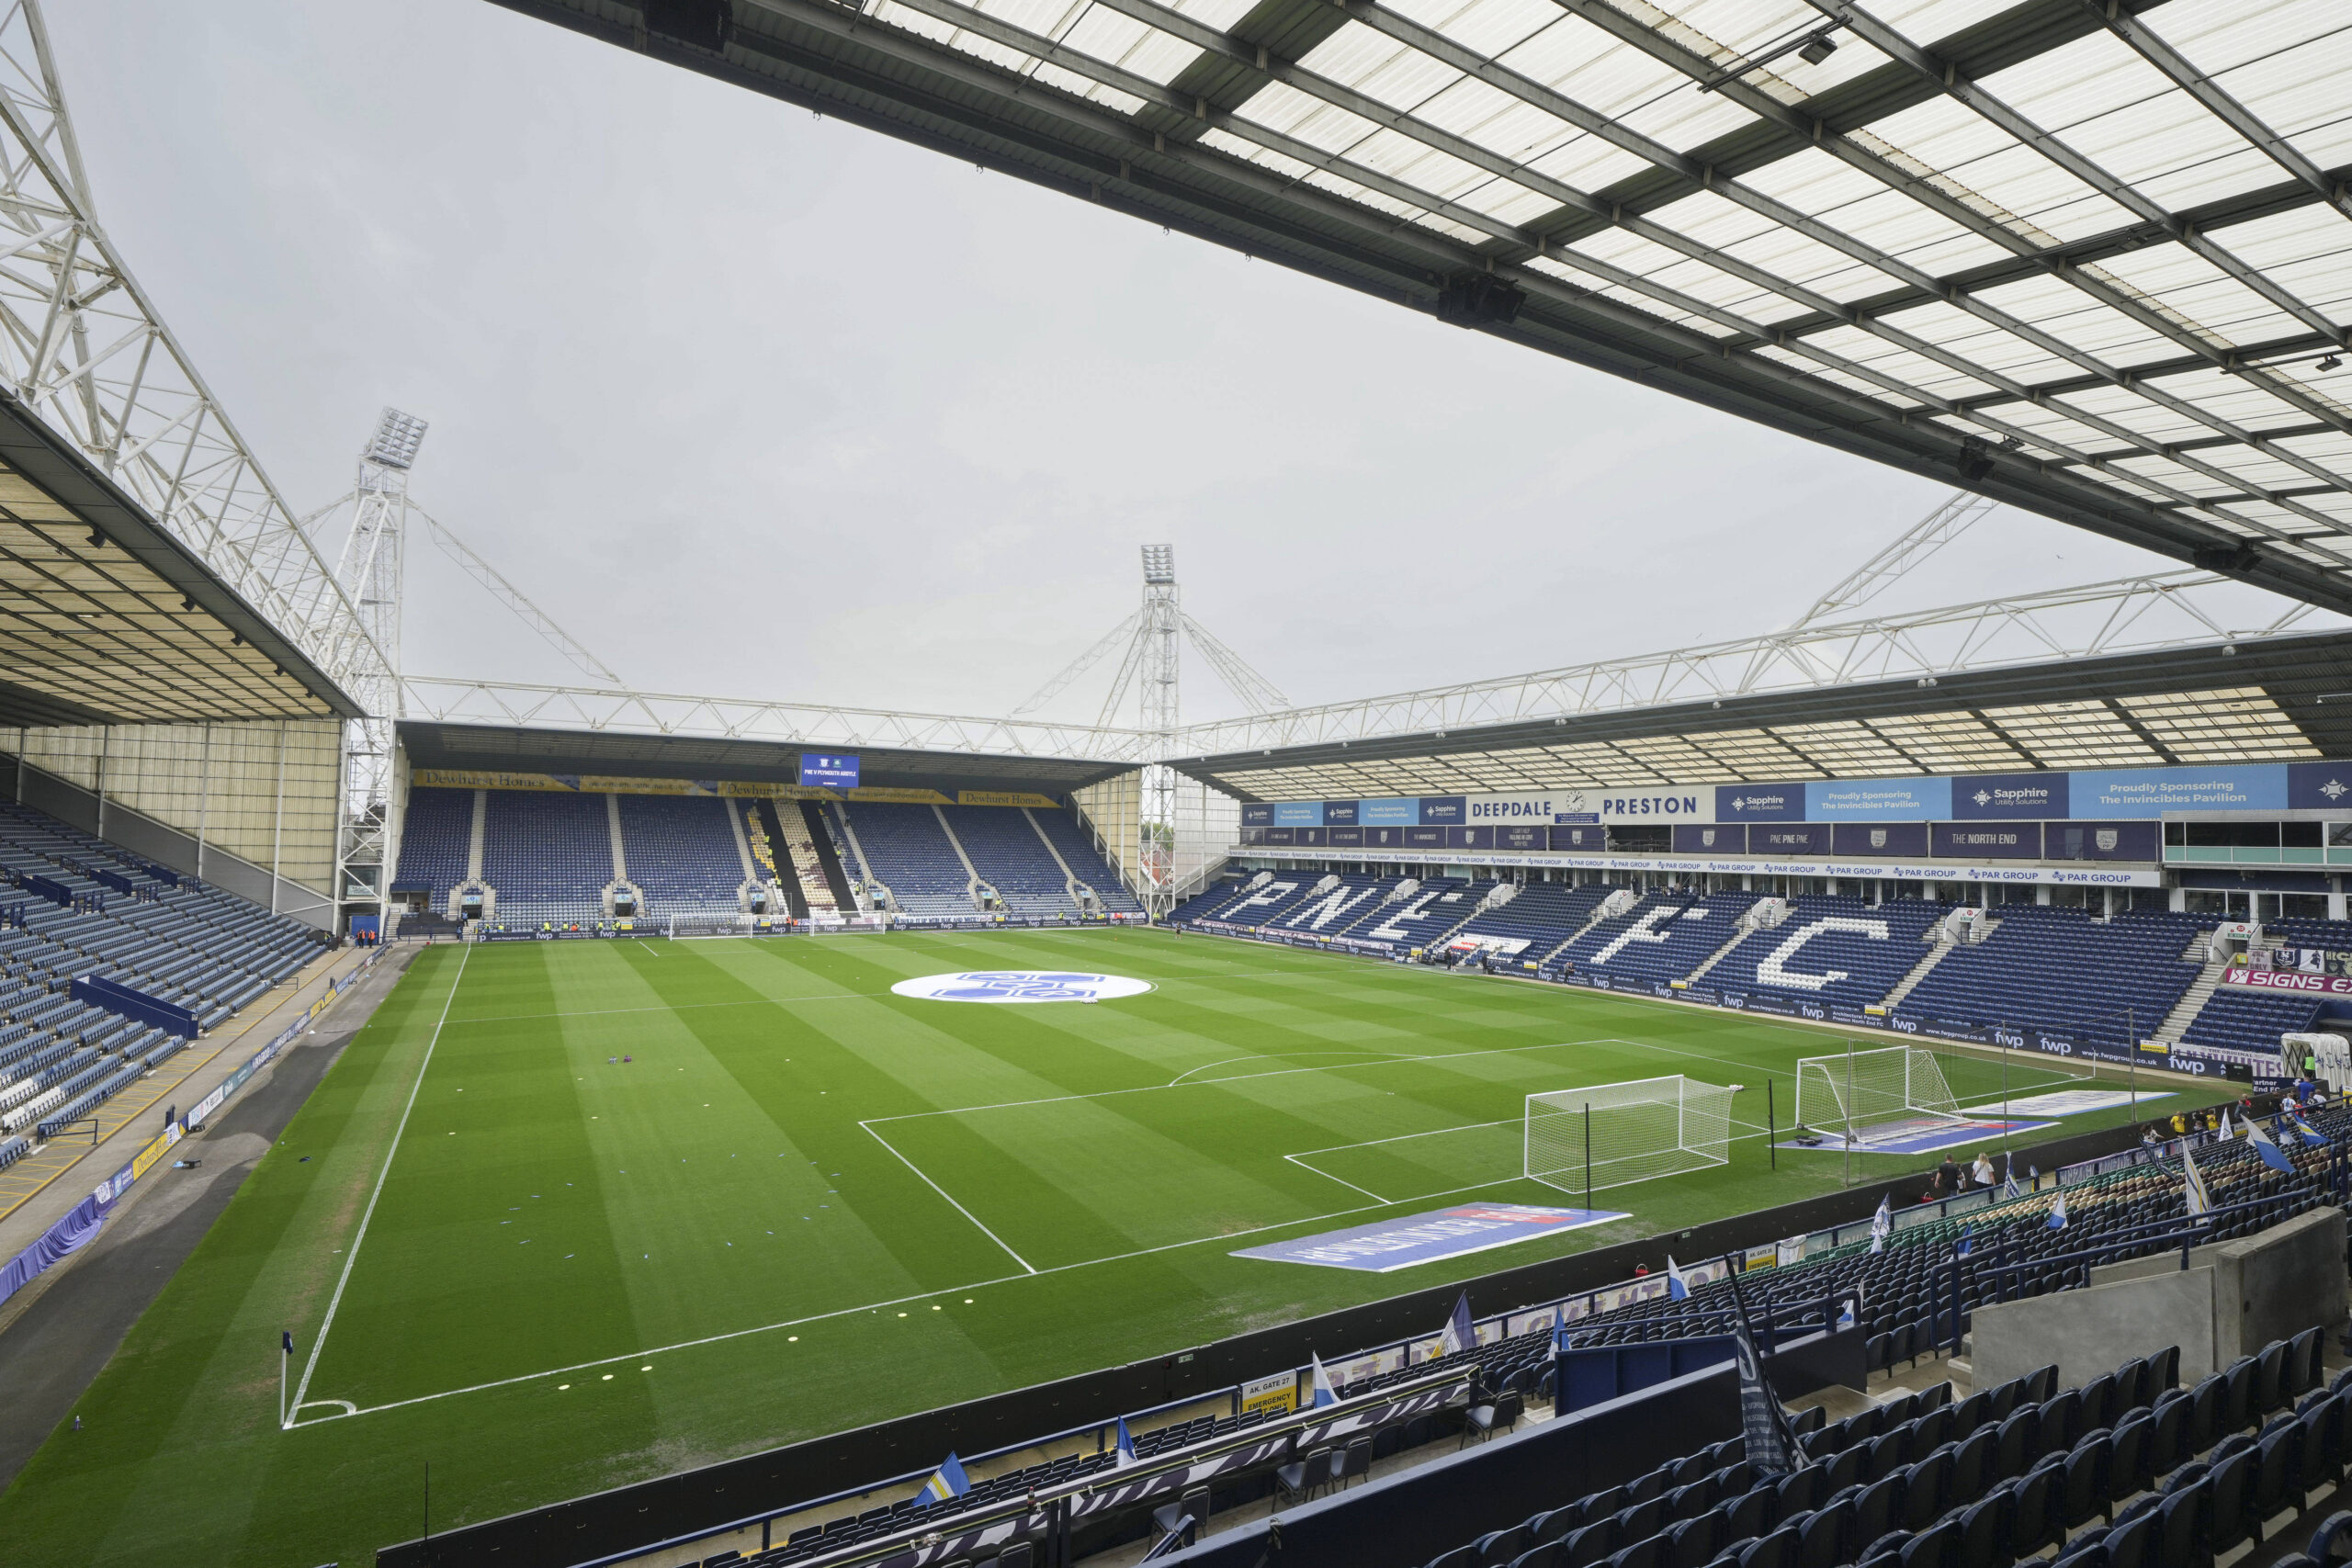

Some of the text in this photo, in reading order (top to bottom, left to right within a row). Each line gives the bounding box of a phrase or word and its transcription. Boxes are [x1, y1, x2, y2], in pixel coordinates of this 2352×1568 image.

[426, 772, 545, 787] Dewhurst Homes
[728, 784, 820, 797] Dewhurst Homes
[1995, 788, 2048, 799] Sapphire
[2109, 781, 2234, 794] Proudly Sponsoring
[966, 794, 1042, 805] Dewhurst Homes
[1747, 795, 1784, 806] Sapphire
[1861, 791, 1912, 800] Sponsoring
[1996, 796, 2048, 807] Utility Solutions
[2099, 793, 2246, 805] The Invincibles Pavilion
[1473, 796, 1697, 817] DEEPDALE PRESTON
[1838, 801, 1883, 809] Invincibles
[1884, 800, 1920, 808] Pavilion
[1770, 834, 1808, 844] PNE PNE PNE
[1952, 834, 2017, 845] THE NORTH END
[1982, 871, 2039, 880] PAR GROUP
[2067, 874, 2132, 883] PAR GROUP
[537, 932, 552, 941] fwp
[600, 931, 616, 939] fwp
[1538, 970, 1552, 981] fwp
[2251, 972, 2325, 990] SIGNS
[1594, 976, 1610, 989] fwp
[1655, 986, 1672, 998] fwp
[1724, 995, 1743, 1009] fwp
[1748, 1004, 1794, 1014] www.fwpgroup.co.uk
[1802, 1006, 1824, 1020] fwp
[1892, 1018, 1917, 1033] fwp
[1926, 1028, 1986, 1042] www.fwpgroup.co.uk
[1995, 1032, 2023, 1048] fwp
[2040, 1037, 2071, 1055] fwp
[2222, 1050, 2254, 1058] ORIGINAL
[2168, 1055, 2205, 1075] fwp
[1250, 1377, 1290, 1394] AK. GATE 27
[1248, 1392, 1291, 1411] EMERGENCY
